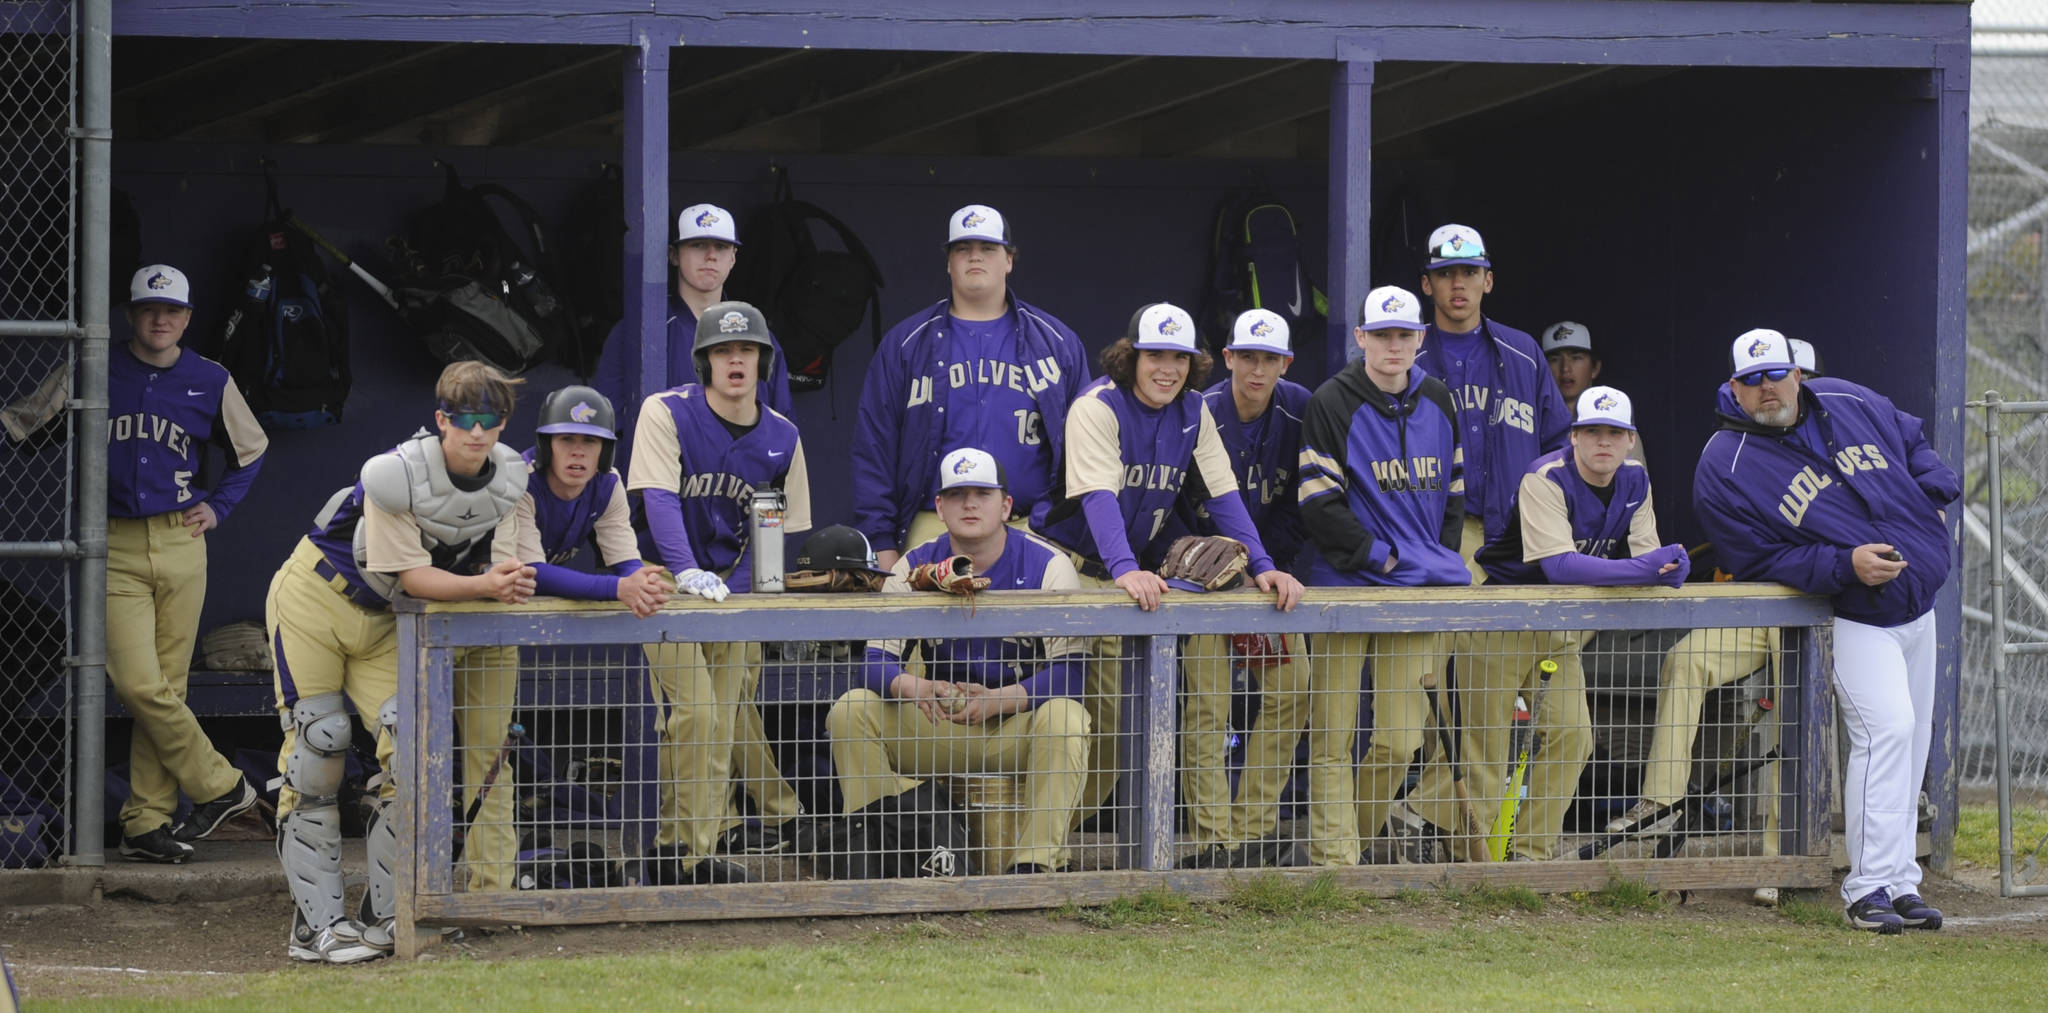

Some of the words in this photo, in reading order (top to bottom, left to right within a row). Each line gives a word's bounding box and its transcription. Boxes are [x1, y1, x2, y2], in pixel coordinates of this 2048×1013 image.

[174, 470, 193, 503] 5
[681, 472, 757, 515] WOLVE
[1778, 444, 1888, 527] WOLVES
